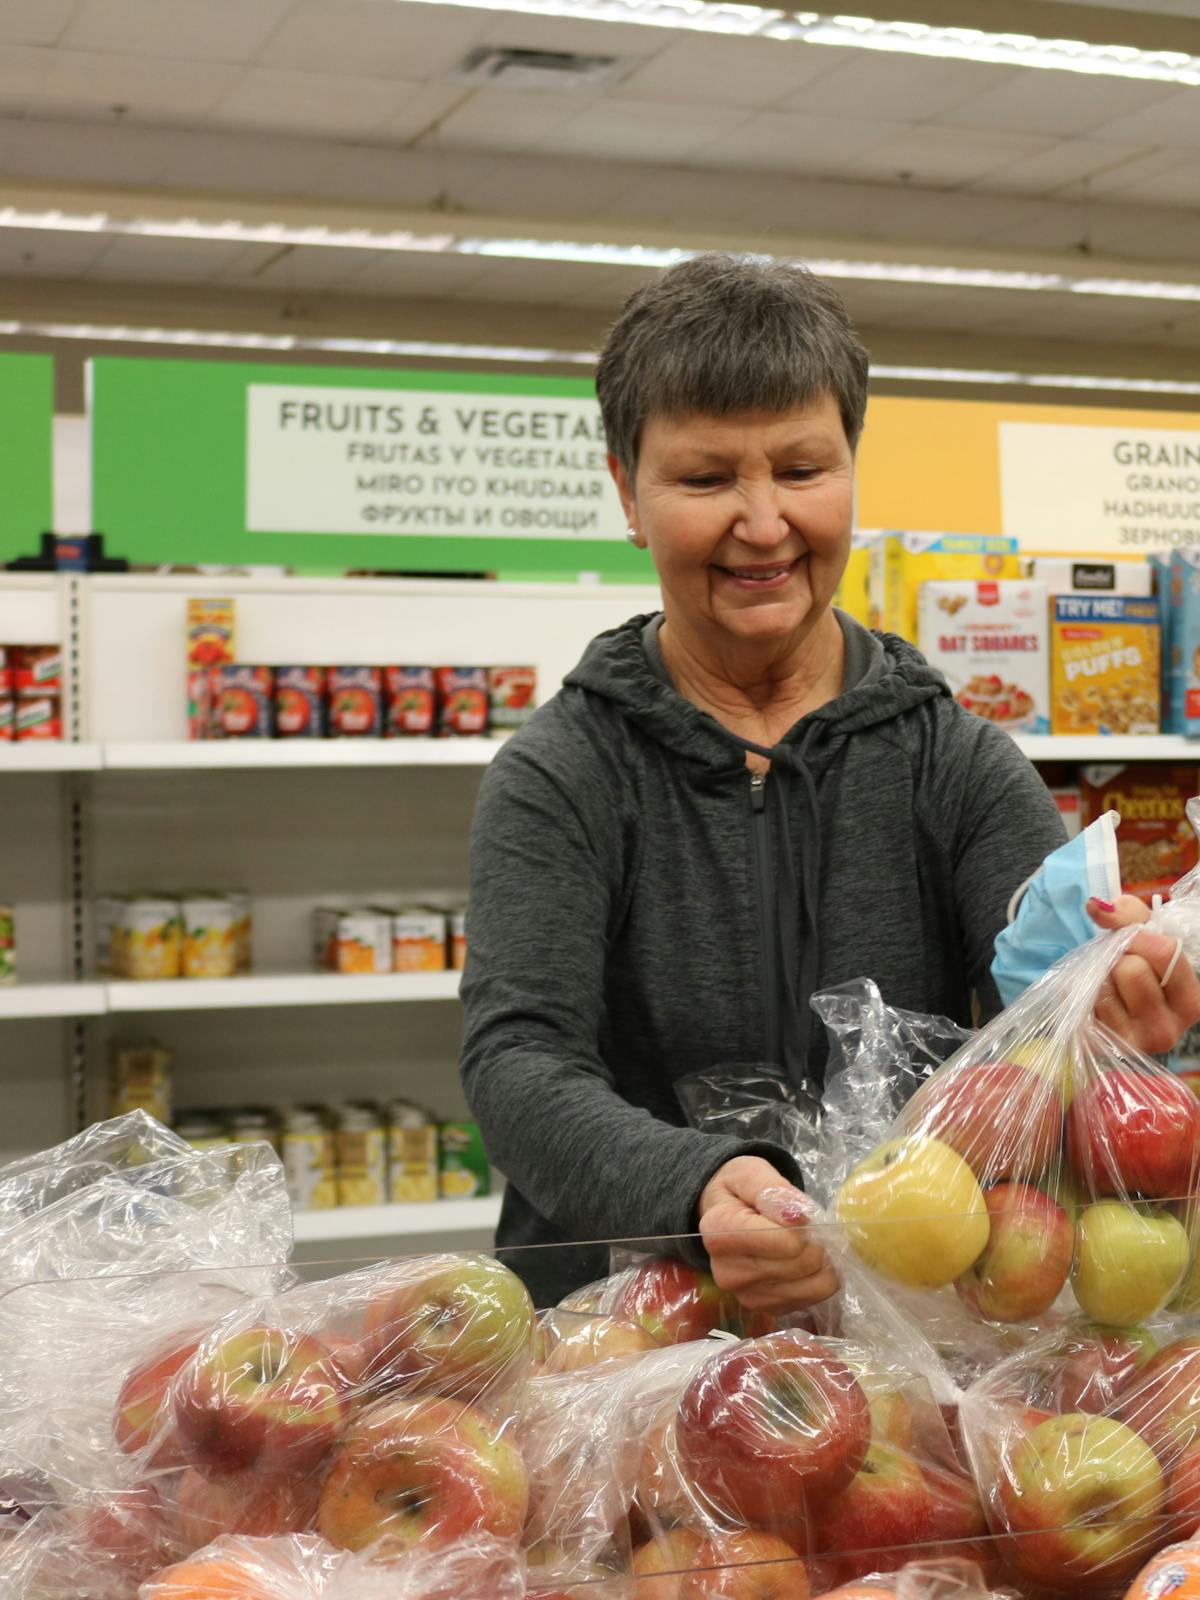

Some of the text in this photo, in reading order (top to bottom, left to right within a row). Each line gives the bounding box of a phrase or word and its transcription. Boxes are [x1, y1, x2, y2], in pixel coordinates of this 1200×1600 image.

[280, 401, 404, 434] FRUITS
[417, 407, 440, 435] &
[347, 443, 441, 465] FRUTAS
[448, 446, 465, 465] Y
[356, 475, 605, 499] MIRO IYO KHUDAAR
[361, 505, 598, 532] ФРУКТЫ И ОВОЩИ
[1056, 599, 1089, 617] TRY
[938, 634, 1038, 652] OAT SQUARES
[1064, 646, 1142, 681] PUFFS
[1103, 790, 1183, 821] Cheerios
